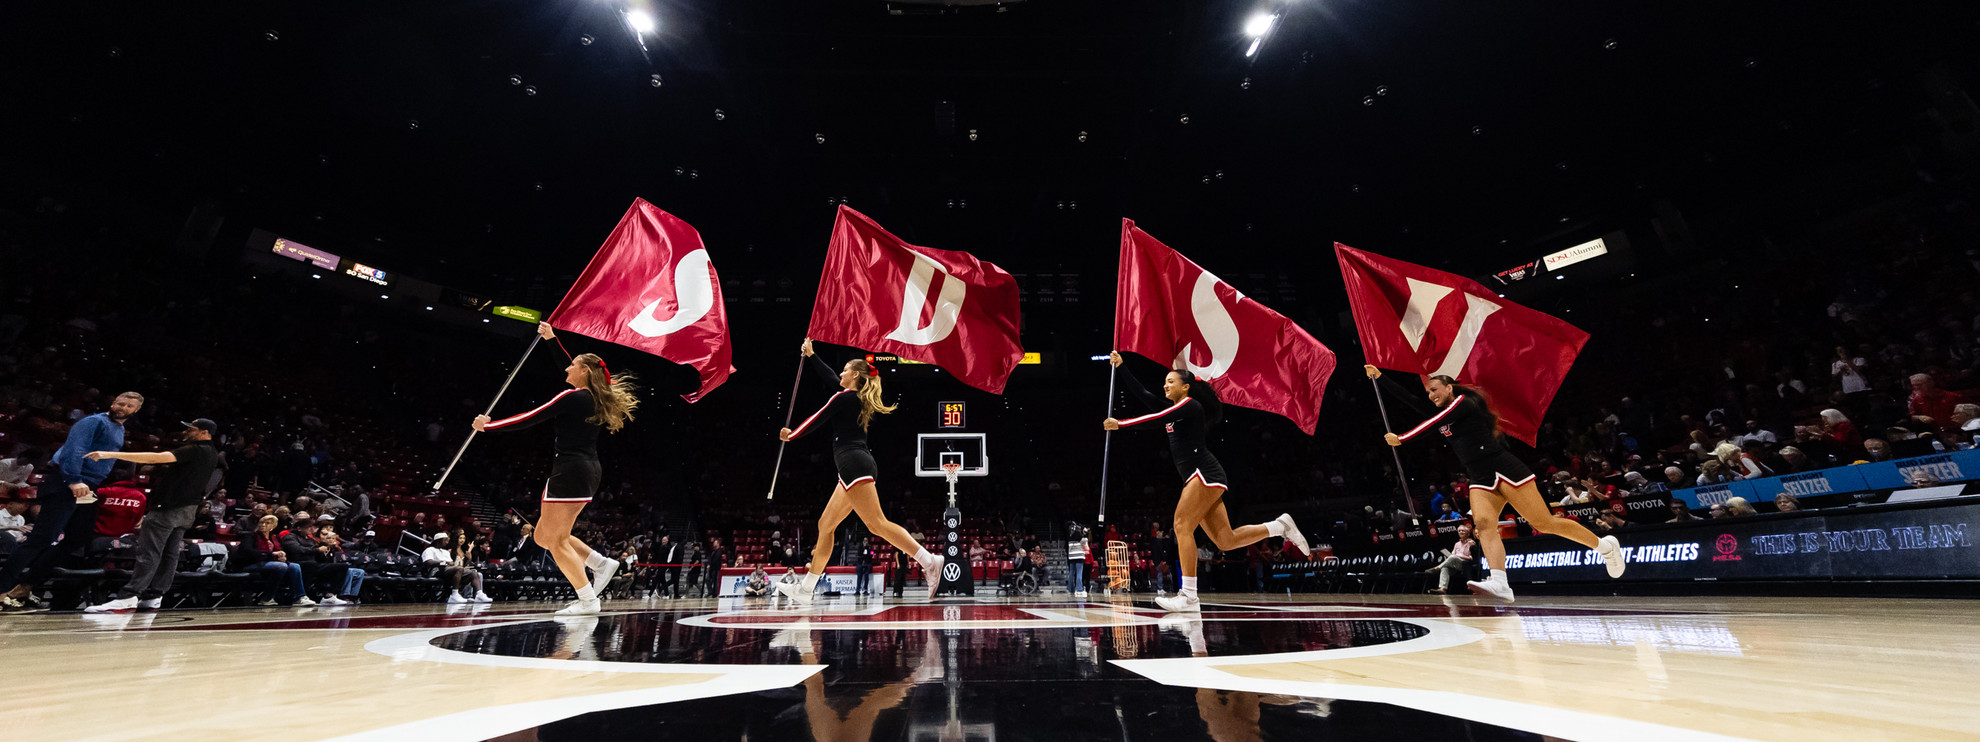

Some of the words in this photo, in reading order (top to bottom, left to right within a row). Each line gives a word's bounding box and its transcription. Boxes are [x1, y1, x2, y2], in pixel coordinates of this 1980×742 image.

[355, 264, 375, 276] FOX
[357, 272, 369, 280] San
[369, 276, 388, 286] Diego
[885, 244, 966, 345] D
[1172, 270, 1246, 381] S
[945, 404, 963, 412] 6:57
[944, 411, 960, 425] 30
[1894, 460, 1918, 468] BUD
[1919, 455, 1953, 465] LIGHT
[1782, 477, 1833, 496] SELTZER
[104, 497, 141, 508] ELITE
[1627, 499, 1666, 511] TOYOTA
[1567, 507, 1600, 517] TOYOTA
[1405, 530, 1424, 538] TOYOTA
[1437, 525, 1457, 534] TOYOTA
[1378, 533, 1395, 541] TOYOTA
[1752, 533, 1796, 555] THIS
[1799, 532, 1820, 553] IS
[1822, 528, 1891, 553] YOUR
[1892, 523, 1973, 550] TEAM
[1504, 554, 1525, 569] ZTEC
[1525, 550, 1582, 569] BASKETBALL
